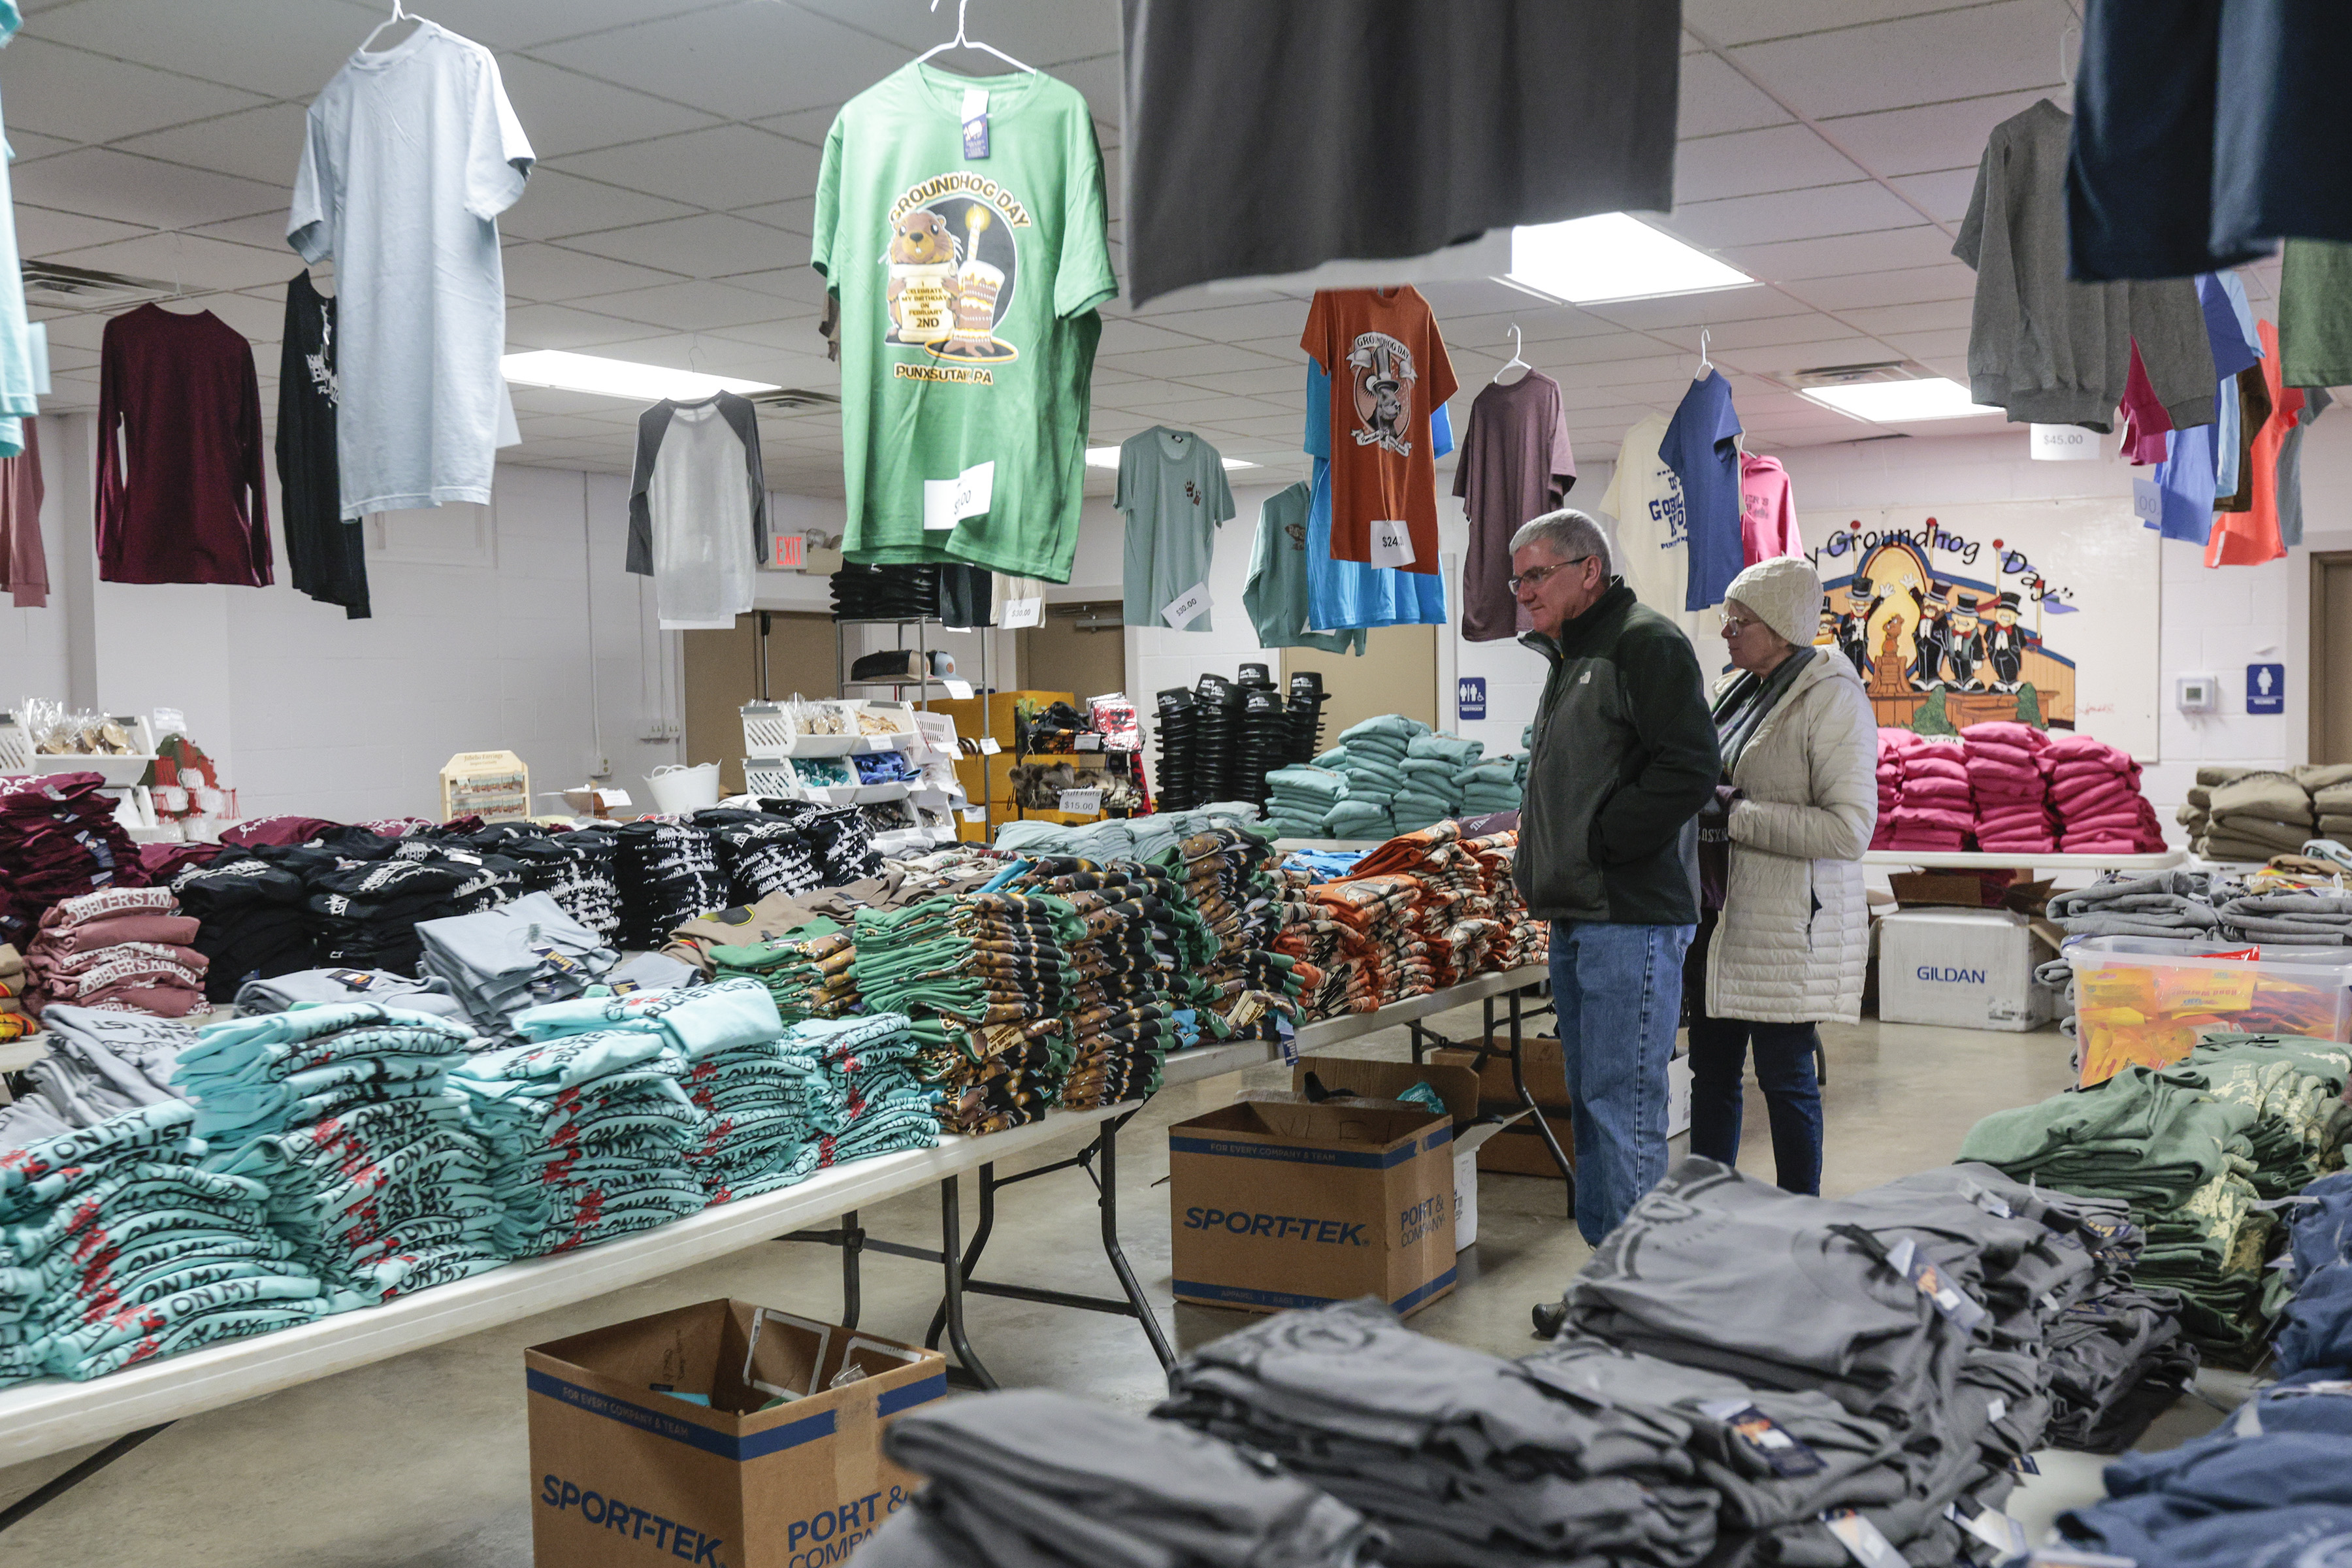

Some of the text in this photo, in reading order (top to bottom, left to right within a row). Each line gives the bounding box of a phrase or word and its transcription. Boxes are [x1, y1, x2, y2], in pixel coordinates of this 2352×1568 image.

[889, 174, 1030, 225] GROUNDHOG DAY
[916, 318, 939, 328] 2ND
[1357, 335, 1410, 359] GRONDHOG DAY
[973, 370, 992, 383] PA
[2044, 434, 2083, 446] $45.00
[776, 536, 802, 566] EXIT
[1827, 523, 1980, 565] Groundhog
[1011, 608, 1031, 617] $30.00
[1176, 598, 1197, 617] $30.00
[1064, 800, 1093, 811] $15.00
[1917, 966, 1985, 985] GILDAN
[52, 1111, 150, 1159] ON MY
[1230, 1145, 1258, 1154] EVERY
[1259, 1147, 1301, 1158] COMPANY
[1311, 1152, 1336, 1162] TEAM
[1183, 1207, 1366, 1247] SPORT-TEK
[1401, 1197, 1435, 1231] PORT
[1435, 1194, 1444, 1213] &
[140, 1267, 234, 1305] ON MY
[171, 1290, 215, 1316] ON
[221, 1279, 261, 1301] MY
[563, 1386, 689, 1436] FOR EVERY COMPANY & TEAM
[540, 1474, 724, 1568] SPORT-TEK
[788, 1491, 882, 1552] PORT
